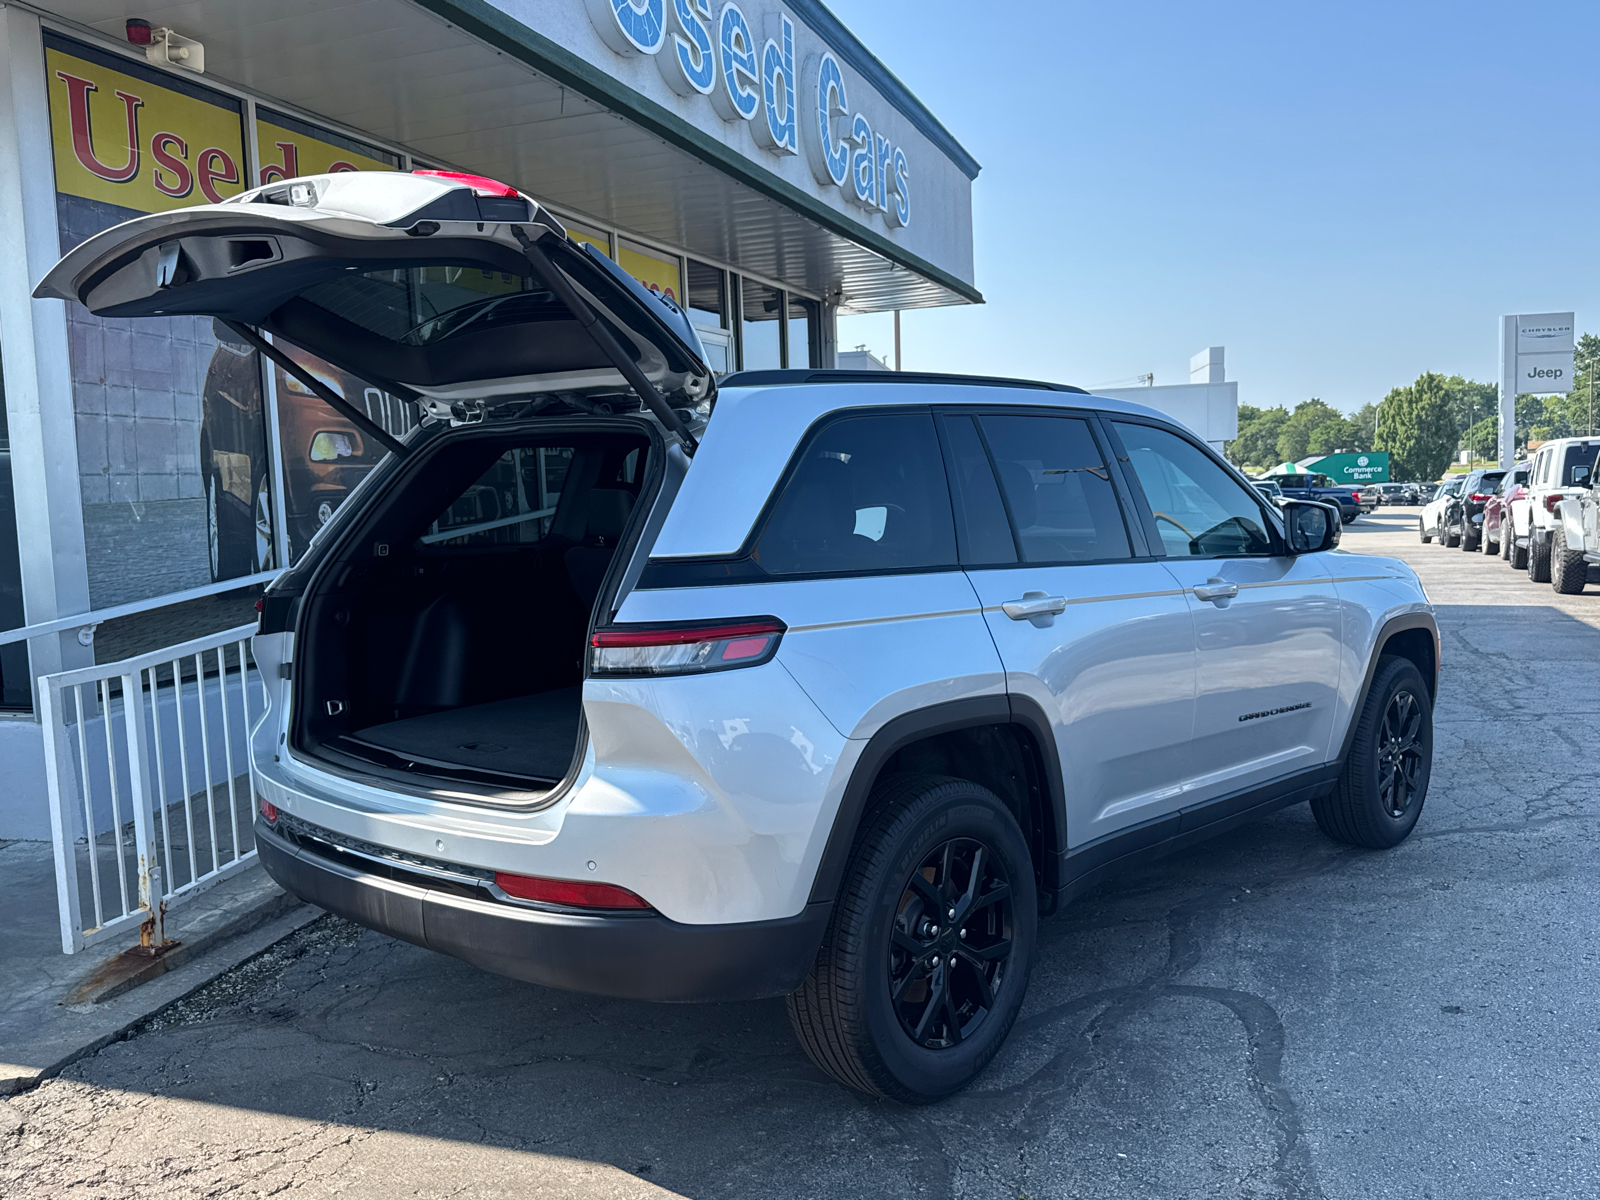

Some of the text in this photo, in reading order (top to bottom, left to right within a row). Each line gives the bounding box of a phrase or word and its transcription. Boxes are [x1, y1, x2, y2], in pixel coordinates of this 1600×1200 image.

[607, 0, 910, 227] sed Cars
[1521, 326, 1570, 334] CHRYSLER
[1527, 366, 1563, 380] Jeep
[1343, 466, 1383, 474] Commerce
[1353, 472, 1372, 480] Bank
[1238, 710, 1269, 722] GRAND
[900, 815, 947, 870] MICHELIN
